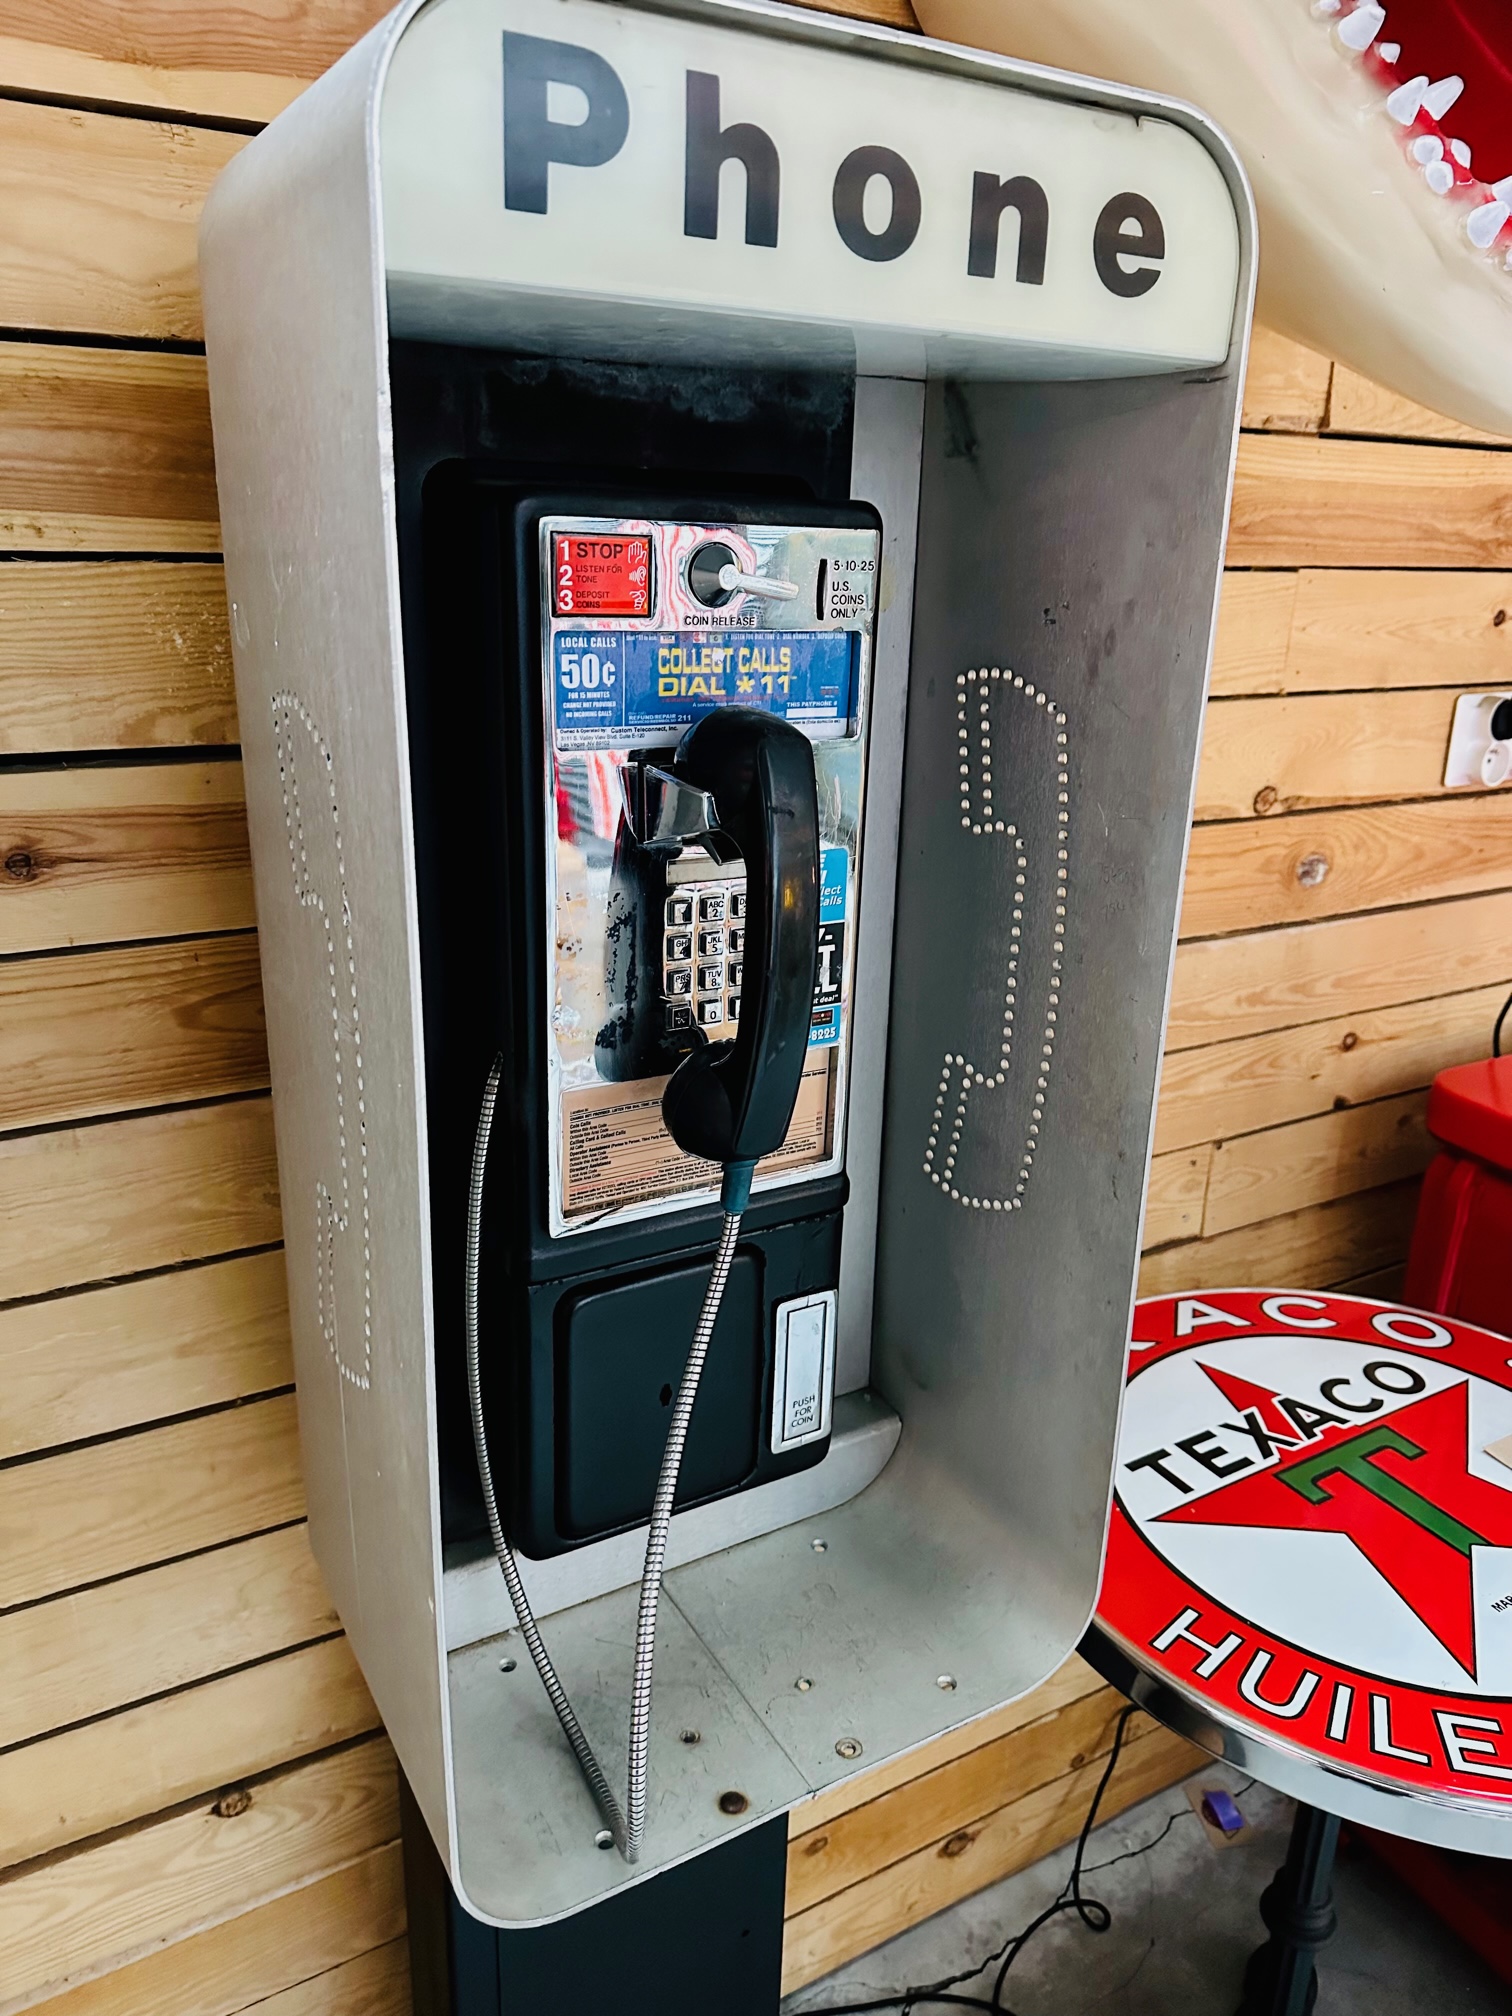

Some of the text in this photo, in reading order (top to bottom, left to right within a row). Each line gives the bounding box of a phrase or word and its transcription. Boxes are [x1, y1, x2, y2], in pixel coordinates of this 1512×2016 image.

[502, 30, 1166, 298] Phone
[560, 540, 623, 561] 1 STOP
[560, 564, 622, 586] 2 LISTEN FOR
[576, 575, 597, 583] TONE
[832, 581, 851, 592] U.S.
[560, 589, 610, 611] 3 DEPOSIT
[576, 601, 600, 609] COINS
[831, 595, 864, 605] COINS
[830, 608, 858, 619] ONLY
[684, 616, 756, 626] COIN RELEASE
[561, 637, 617, 648] LOCAL CALLS
[658, 647, 791, 675] COLLECT CALLS
[658, 676, 726, 697] DIAL
[586, 691, 610, 699] MINUTES
[677, 714, 691, 722] 211
[820, 885, 842, 896] lect
[712, 909, 718, 918] 2
[708, 936, 722, 944] JKL
[712, 944, 718, 953] 5
[711, 978, 717, 987] 8
[710, 1011, 716, 1019] 0
[792, 1394, 816, 1409] PUSH
[794, 1406, 812, 1418] FOR
[791, 1414, 814, 1428] COIN
[1124, 1361, 1427, 1496] TEXACO
[1272, 1424, 1492, 1557] T
[1149, 1605, 1512, 1783] HUILE
